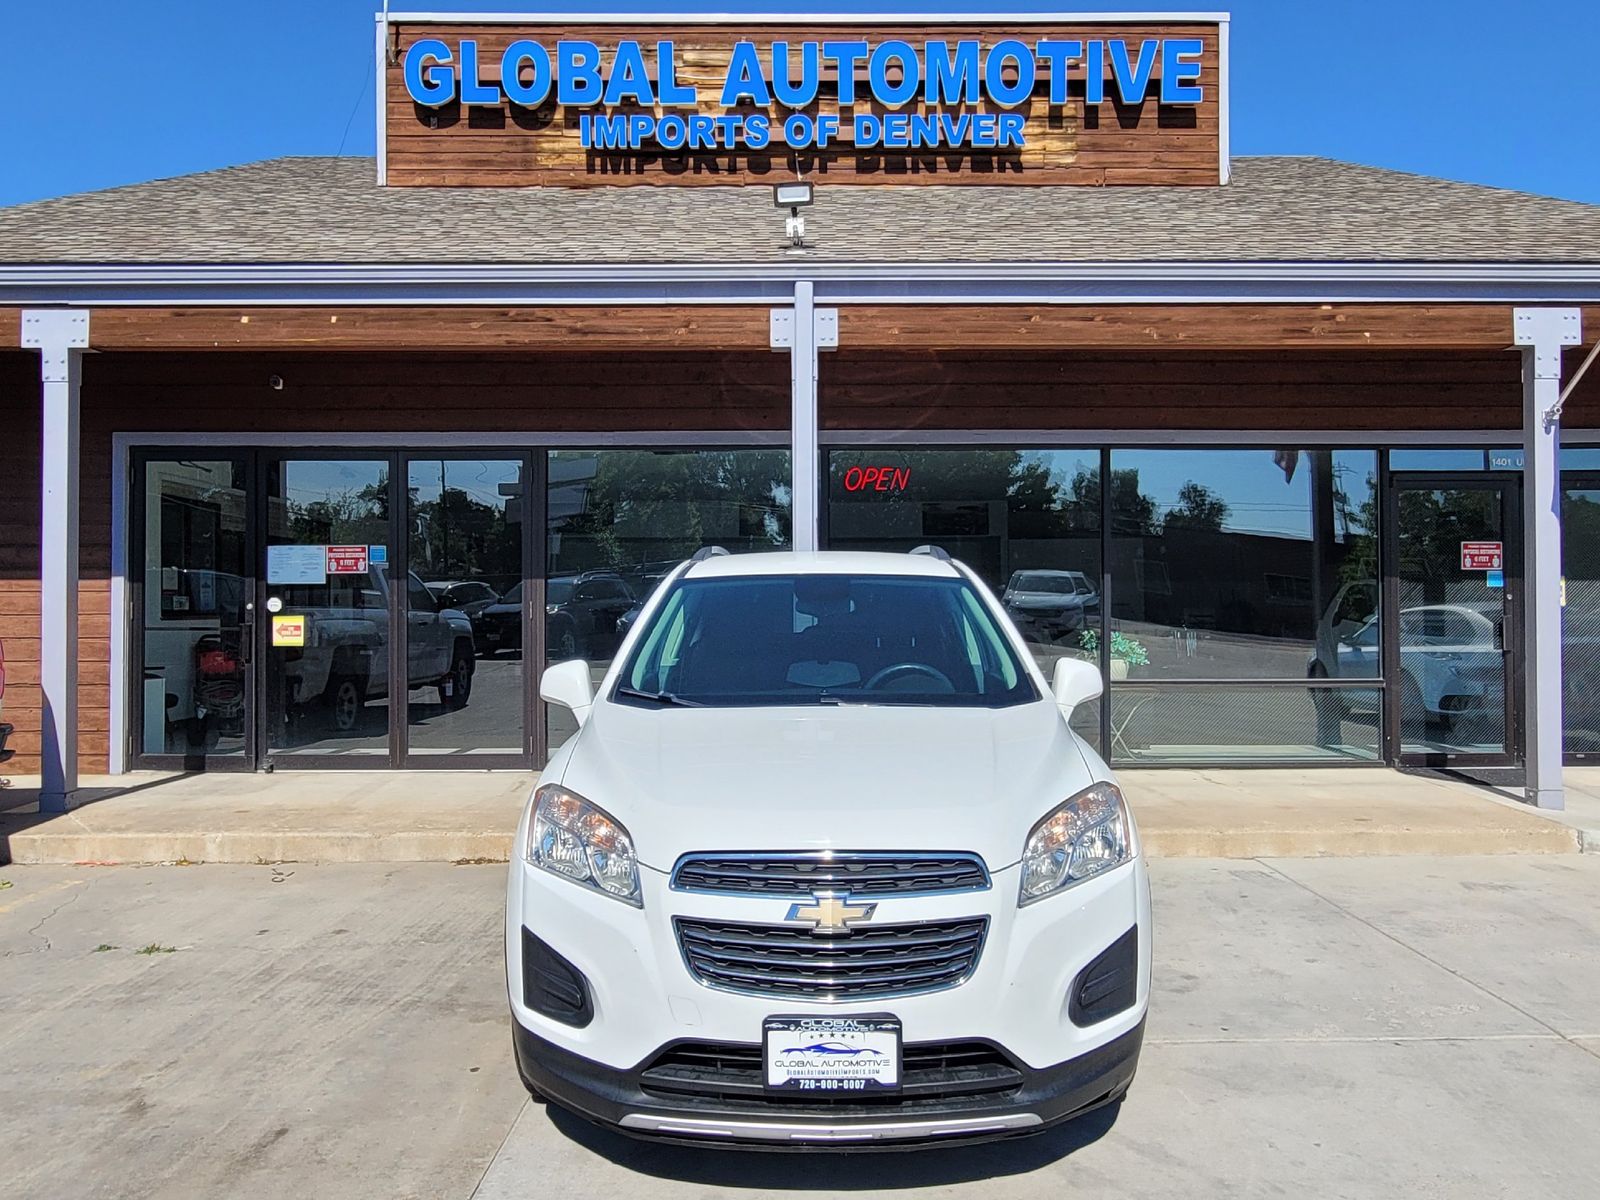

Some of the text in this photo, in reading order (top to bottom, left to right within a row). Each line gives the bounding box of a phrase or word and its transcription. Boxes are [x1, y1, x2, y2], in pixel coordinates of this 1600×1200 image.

[403, 39, 1204, 107] GLOBAL AUTOMOTIVE
[580, 115, 1026, 150] IMPORTS OF DENVER
[1492, 457, 1511, 467] 1401
[844, 465, 911, 491] OPEN
[800, 1019, 865, 1028] GLOBAL
[774, 1059, 891, 1068] GLOBAL AUTOMOTIVE
